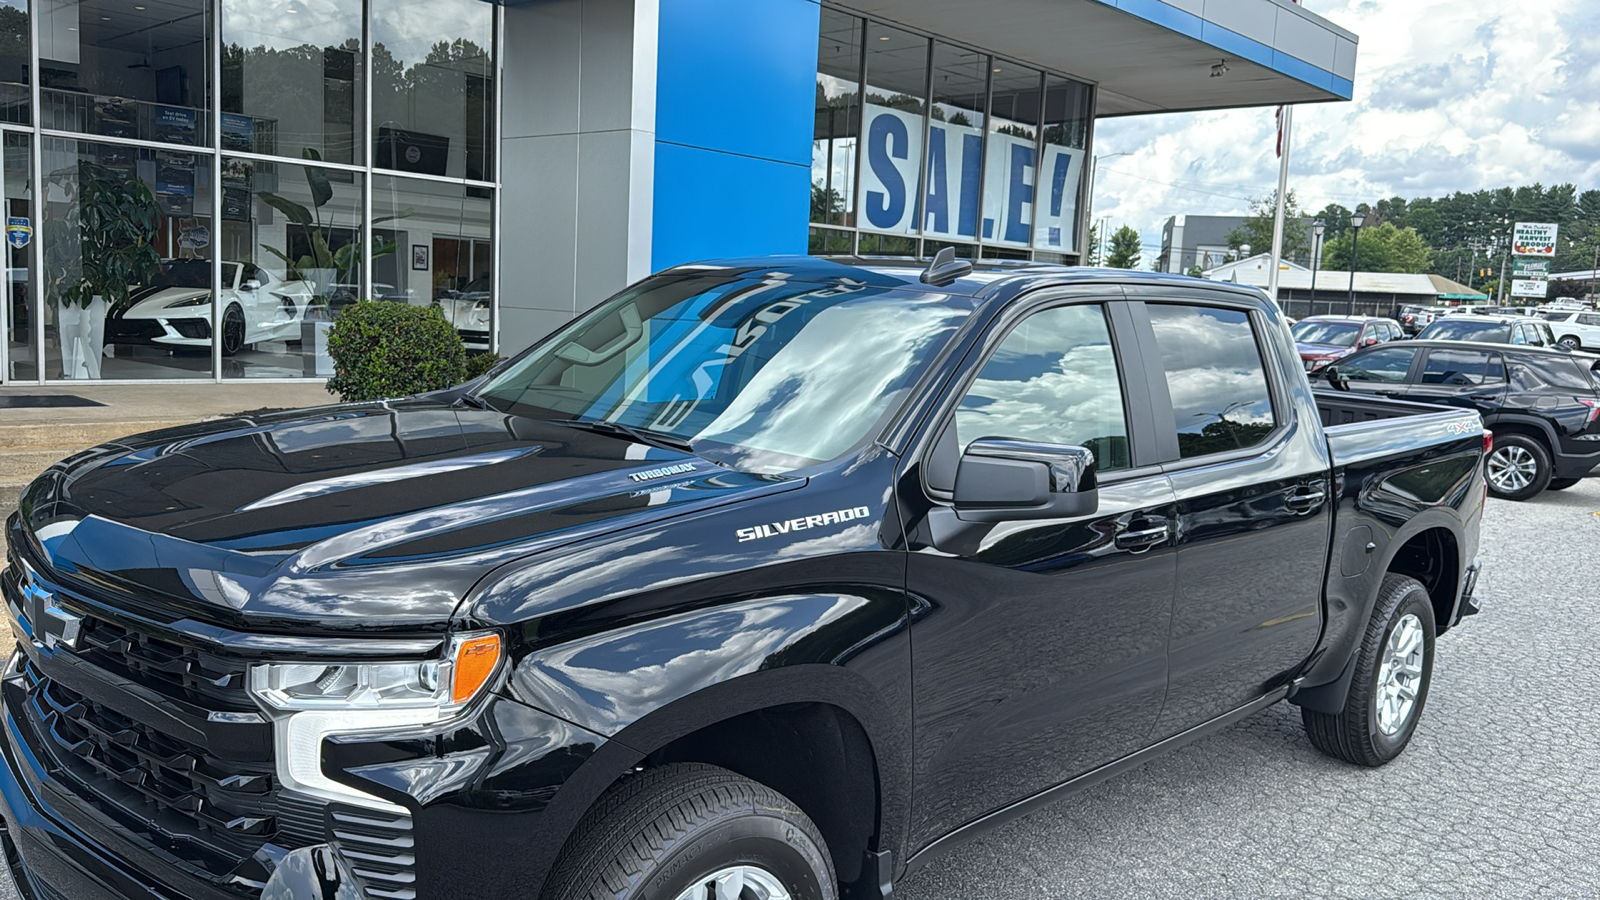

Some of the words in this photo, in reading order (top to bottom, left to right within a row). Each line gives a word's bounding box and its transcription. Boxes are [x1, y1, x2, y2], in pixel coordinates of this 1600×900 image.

[866, 113, 1072, 246] SALE!
[628, 462, 697, 483] TURBOMAX
[735, 506, 870, 542] SILVERADO
[655, 842, 704, 889] PRIMACY
